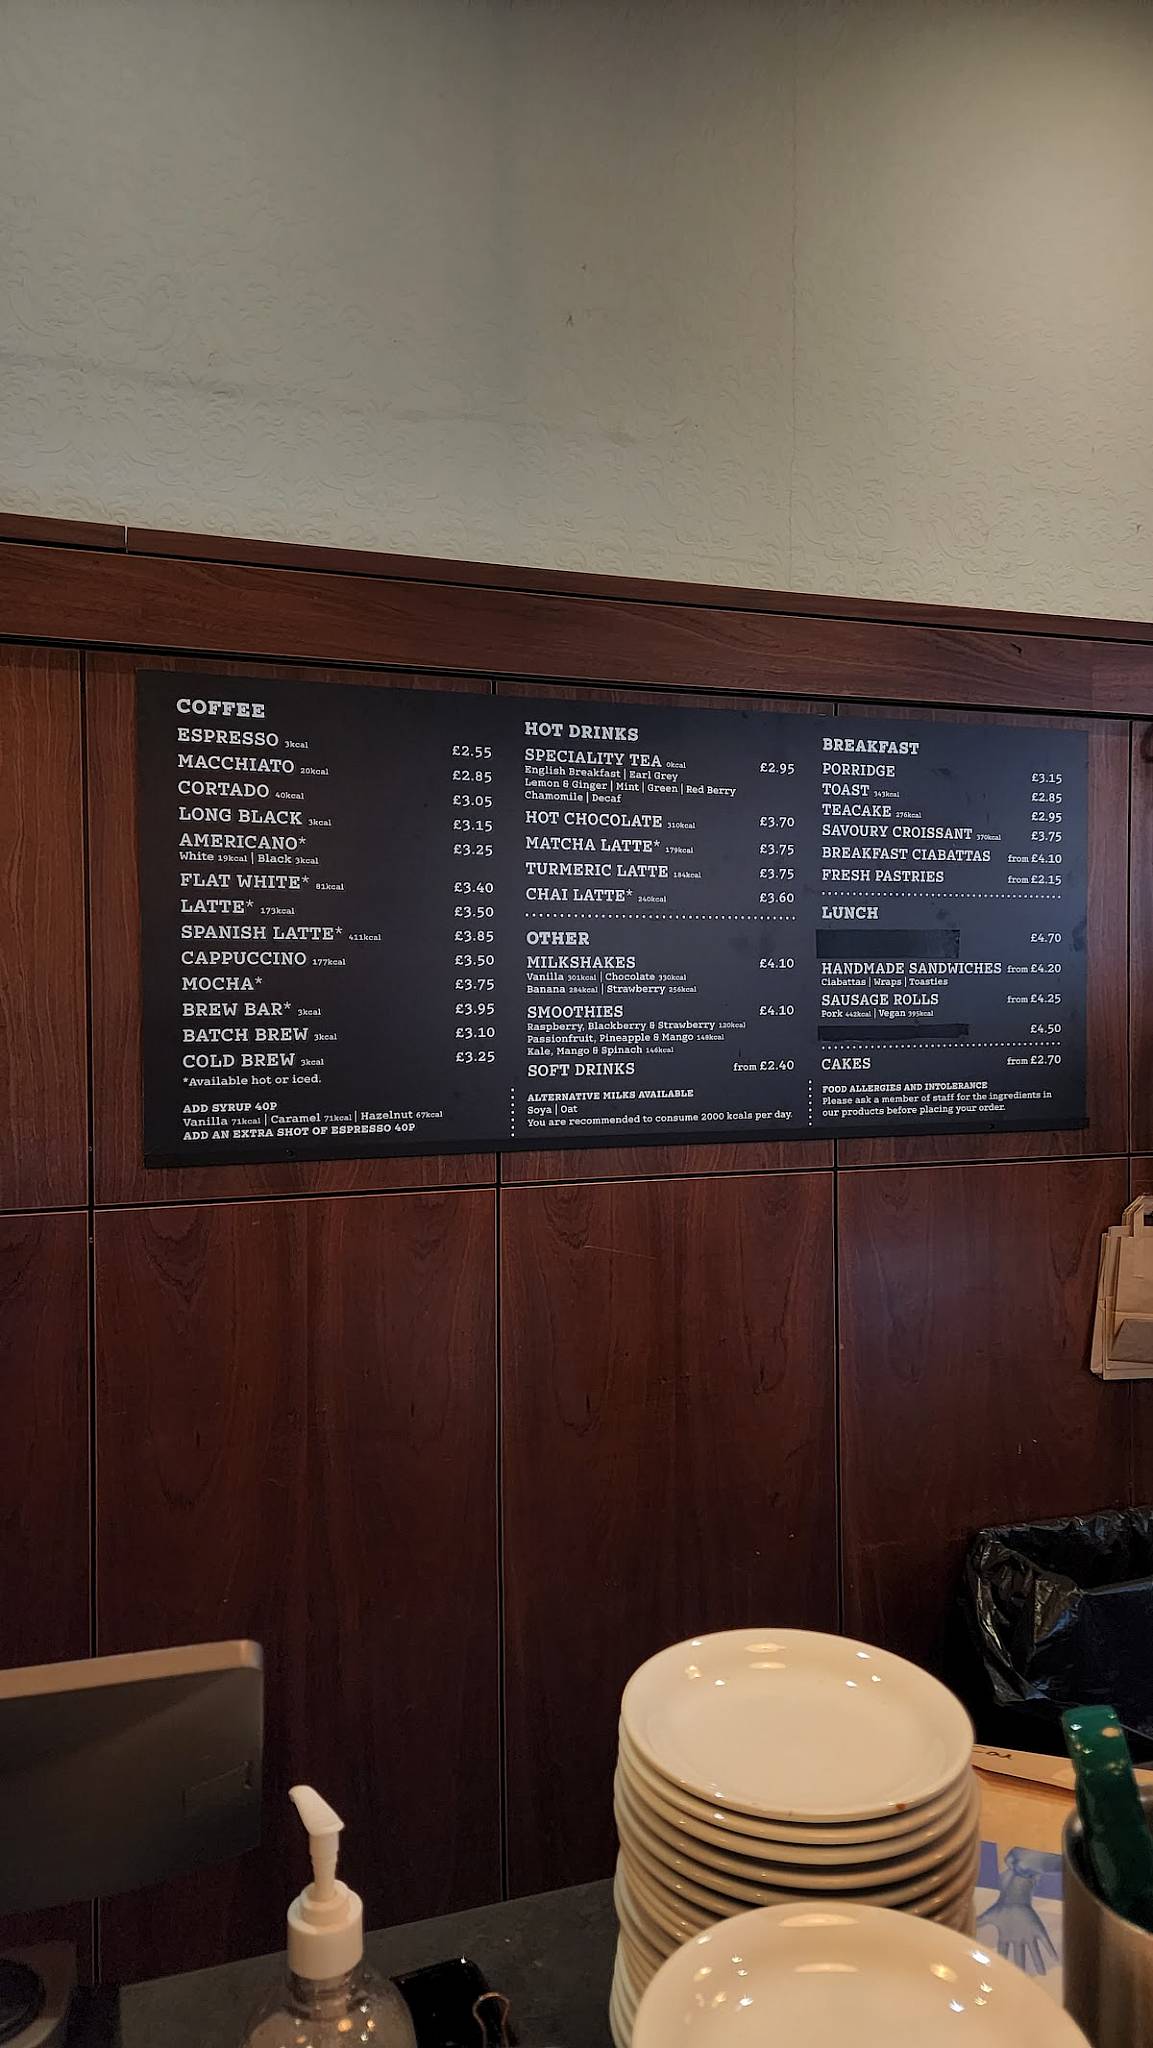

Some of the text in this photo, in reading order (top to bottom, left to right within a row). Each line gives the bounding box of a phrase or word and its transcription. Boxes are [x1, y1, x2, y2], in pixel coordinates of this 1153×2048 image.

[176, 698, 265, 718] COFFEE
[525, 722, 638, 741] HOT DRINKS
[177, 728, 308, 748] ESPRESSO 3kcal
[452, 746, 491, 758] £2.55
[822, 738, 919, 754] BREAKFAST
[178, 754, 294, 773] MACCHIATO
[525, 748, 625, 765] SPECIALITY
[629, 754, 662, 767] TEA
[525, 765, 678, 782] English Breakfast Earl Grey
[760, 762, 794, 775] £2.95
[822, 762, 895, 777] PORRIDGE
[452, 770, 492, 783] £2.85
[1032, 773, 1062, 784] £3.15
[178, 780, 269, 798] CORTADO
[525, 778, 736, 797] Lemon Ginger Mint Green Red Berry
[822, 783, 870, 796] TOAST
[453, 795, 492, 808] £3.05
[525, 790, 622, 803] Chamomile Decaf
[1032, 792, 1062, 804] £2.85
[179, 806, 231, 822] LONG
[238, 809, 303, 825] BLACK
[822, 804, 891, 817] TEACAKE
[526, 811, 662, 828] HOT CHOCOLATE
[760, 816, 794, 828] £3.70
[1032, 812, 1062, 823] £2.95
[453, 820, 492, 832] £3.15
[822, 824, 972, 840] SAVOURY CROISSANT
[1031, 831, 1062, 842] £3.75
[526, 836, 596, 851] MATCHA
[453, 844, 493, 856] £3.25
[760, 844, 794, 856] £3.75
[822, 846, 990, 862] BREAKFAST CIABATTAS
[179, 851, 214, 861] White
[258, 854, 292, 863] Black
[1008, 854, 1062, 864] from £4.10
[526, 862, 668, 878] TURMERIC LATTE
[760, 868, 794, 880] £3.75
[822, 869, 944, 882] FRESH PASTRIES
[180, 873, 231, 887] FLAT
[1008, 874, 1062, 885] from £2.15
[454, 882, 493, 894] £3.40
[526, 888, 568, 900] CHAI
[760, 892, 794, 904] £3.60
[454, 906, 494, 918] £3.50
[822, 906, 878, 919] LUNCH
[181, 925, 266, 939] SPANISH
[454, 930, 494, 942] £3.85
[526, 931, 590, 945] OTHER
[1030, 933, 1061, 944] £4.70
[181, 951, 307, 965] CAPPUCCINO
[455, 954, 494, 966] £3.50
[527, 956, 635, 968] MILKSHAKES
[760, 958, 794, 968] £4.10
[822, 963, 1002, 974] HANDMADE SANDWICHES
[1007, 964, 1061, 973] from £4.20
[526, 972, 655, 980] Vanilla Chocolate
[455, 978, 494, 990] £3.75
[821, 977, 948, 988] Ciabattas Wraps Toasties
[527, 984, 666, 995] Banana Strawberry
[822, 994, 938, 1006] SAUSAGE ROLLS
[1030, 994, 1061, 1004] £4.25
[182, 1003, 238, 1016] BREW
[298, 1008, 321, 1016] 3kcal
[455, 1003, 494, 1015] £3.95
[528, 1005, 623, 1018] SMOOTHIES
[760, 1005, 794, 1015] £4.10
[821, 1009, 906, 1019] Pork Vegan
[182, 1028, 337, 1042] BATCH BREW 3kcal
[455, 1027, 495, 1039] £3.10
[1030, 1024, 1061, 1034] £4.50
[183, 1053, 324, 1068] COLD BREW 3kcal
[456, 1051, 495, 1063] £3.25
[1007, 1055, 1061, 1065] from £2.70
[528, 1062, 634, 1076] SOFT DRINKS
[733, 1060, 794, 1071] from £2.40
[822, 1058, 871, 1070] CAKES
[251, 1075, 272, 1084] hot
[292, 1074, 321, 1083] iced.
[183, 1102, 277, 1113] ADD SYRUP 40P
[528, 1105, 578, 1116] Soya Oat
[841, 1107, 884, 1118] products
[886, 1106, 917, 1114] before
[919, 1105, 954, 1115] placing
[955, 1106, 977, 1114] your
[182, 1110, 413, 1126] Vanilla Caramel Hazelnut
[527, 1119, 546, 1127] You
[569, 1115, 640, 1126] recommended
[701, 1112, 724, 1121] 2000
[726, 1111, 752, 1120] kcals
[755, 1112, 772, 1121] per
